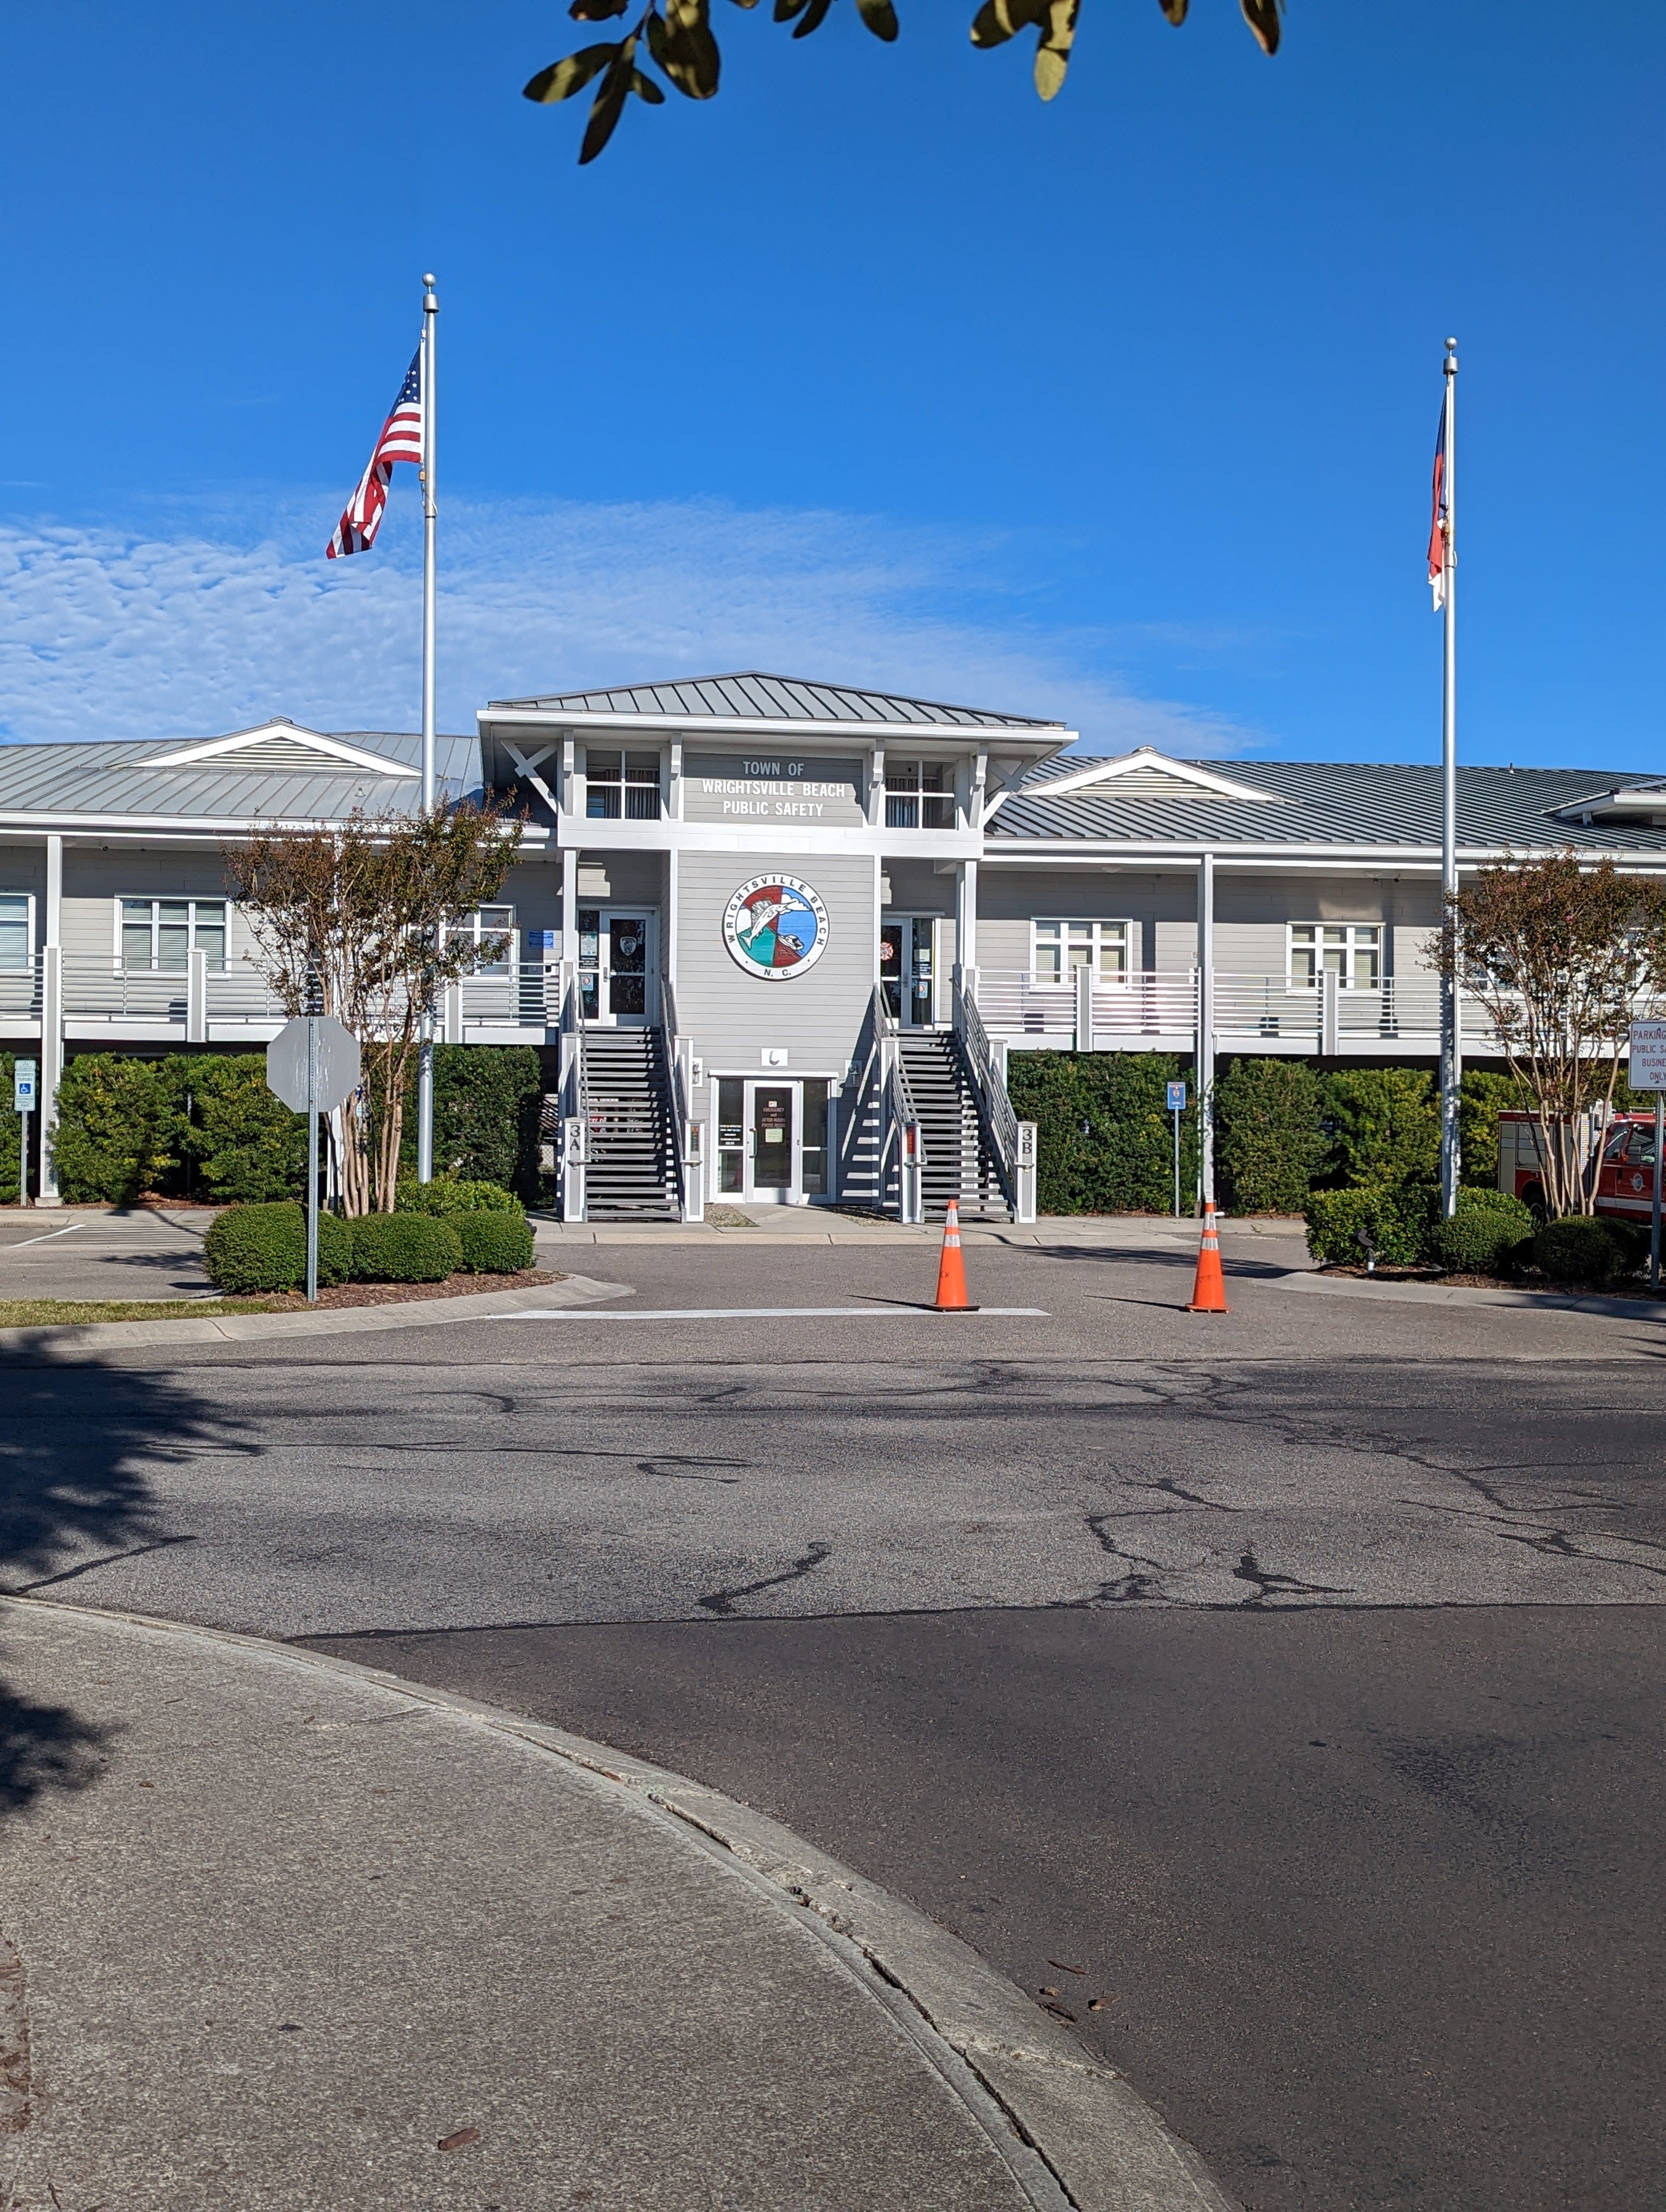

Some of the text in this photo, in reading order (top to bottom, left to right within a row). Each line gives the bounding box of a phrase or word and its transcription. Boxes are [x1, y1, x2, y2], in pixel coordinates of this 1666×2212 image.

[743, 761, 804, 776] TOWN OF
[702, 779, 845, 798] WRIGHTSVILLE BEACH
[723, 801, 823, 817] PUBLIC SAFETY
[726, 876, 826, 946] WRIGHTSVILLE BEACH
[764, 968, 773, 976] N.
[1633, 1030, 1666, 1040] PARKING
[1632, 1045, 1656, 1053] PUBLIC
[1650, 1072, 1666, 1081] ONLY
